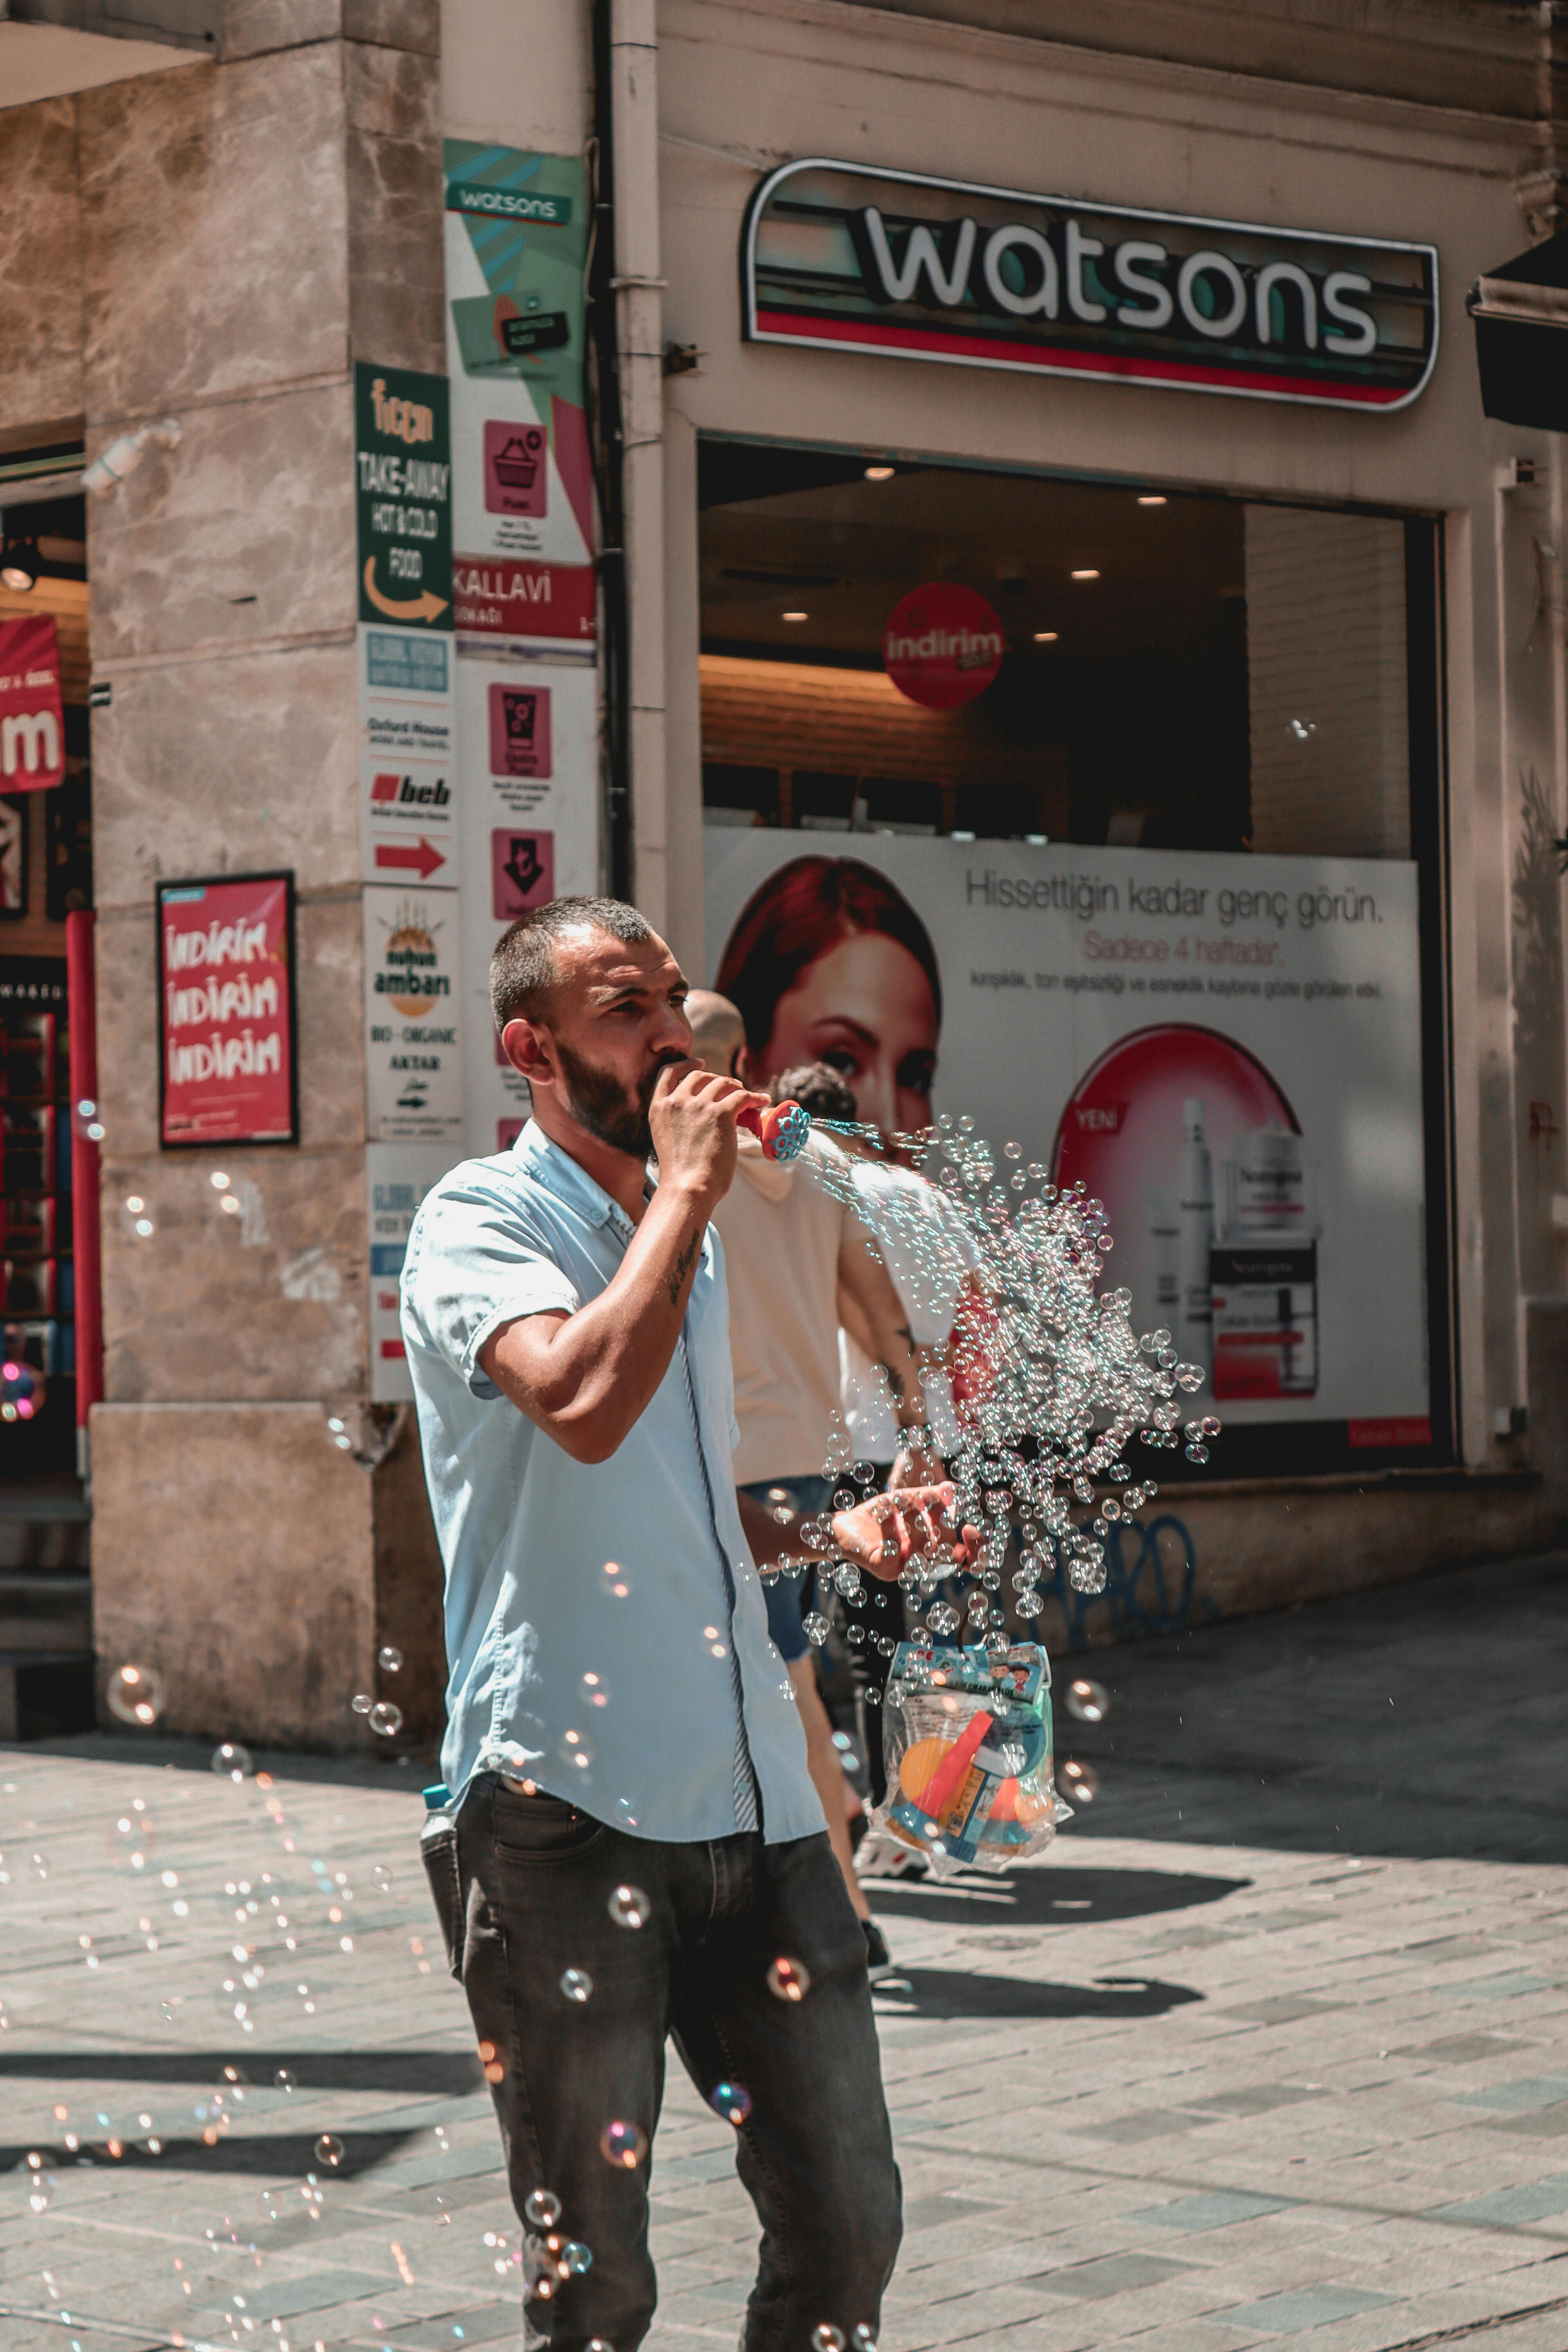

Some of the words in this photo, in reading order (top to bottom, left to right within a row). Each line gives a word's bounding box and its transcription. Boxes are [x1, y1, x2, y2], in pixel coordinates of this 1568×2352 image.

[459, 189, 557, 218] watsons
[864, 205, 1378, 356] watsons
[358, 451, 450, 502] TAKE-AWAY
[886, 628, 1002, 661] indirim
[399, 774, 452, 806] beb
[964, 868, 1120, 923] Hissettiğin
[1129, 877, 1208, 918] kadar
[1217, 887, 1289, 927] genç
[1297, 885, 1384, 931] görün.
[1084, 929, 1171, 963] Sadece
[1175, 935, 1189, 963] 4
